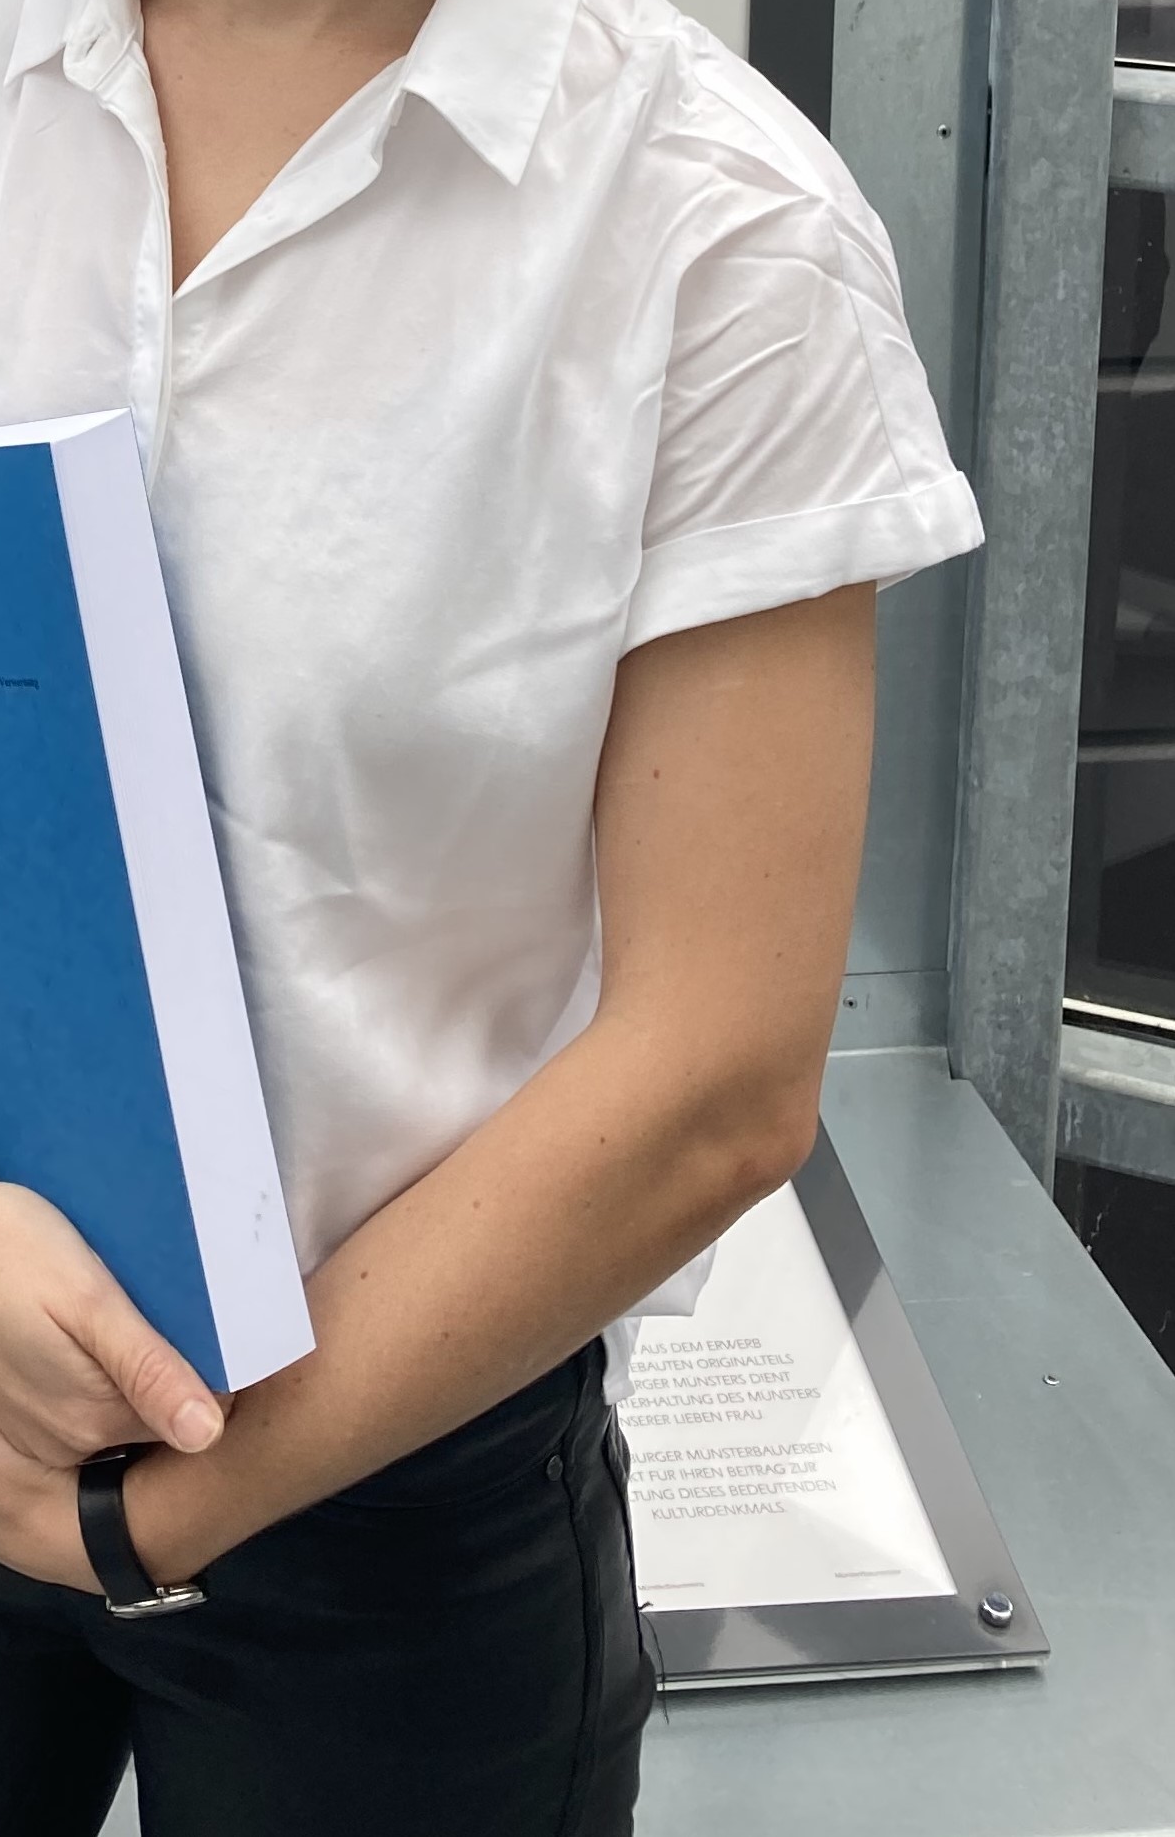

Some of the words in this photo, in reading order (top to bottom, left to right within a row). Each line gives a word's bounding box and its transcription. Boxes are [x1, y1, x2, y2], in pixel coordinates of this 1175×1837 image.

[640, 1343, 668, 1355] AUS
[670, 1341, 704, 1353] DEM
[706, 1338, 762, 1351] ERWERB
[696, 1354, 795, 1369] ORIGINALTEILS
[749, 1371, 792, 1384] DIENT
[717, 1391, 745, 1404] DES
[673, 1411, 723, 1425] LIEBEN
[725, 1409, 763, 1422] FRAU
[679, 1466, 724, 1481] IHREN
[726, 1463, 787, 1478] BEITRAG
[789, 1461, 819, 1475] ZUR
[678, 1485, 726, 1499] DIESES
[728, 1479, 838, 1498] BEDEUTENDEN
